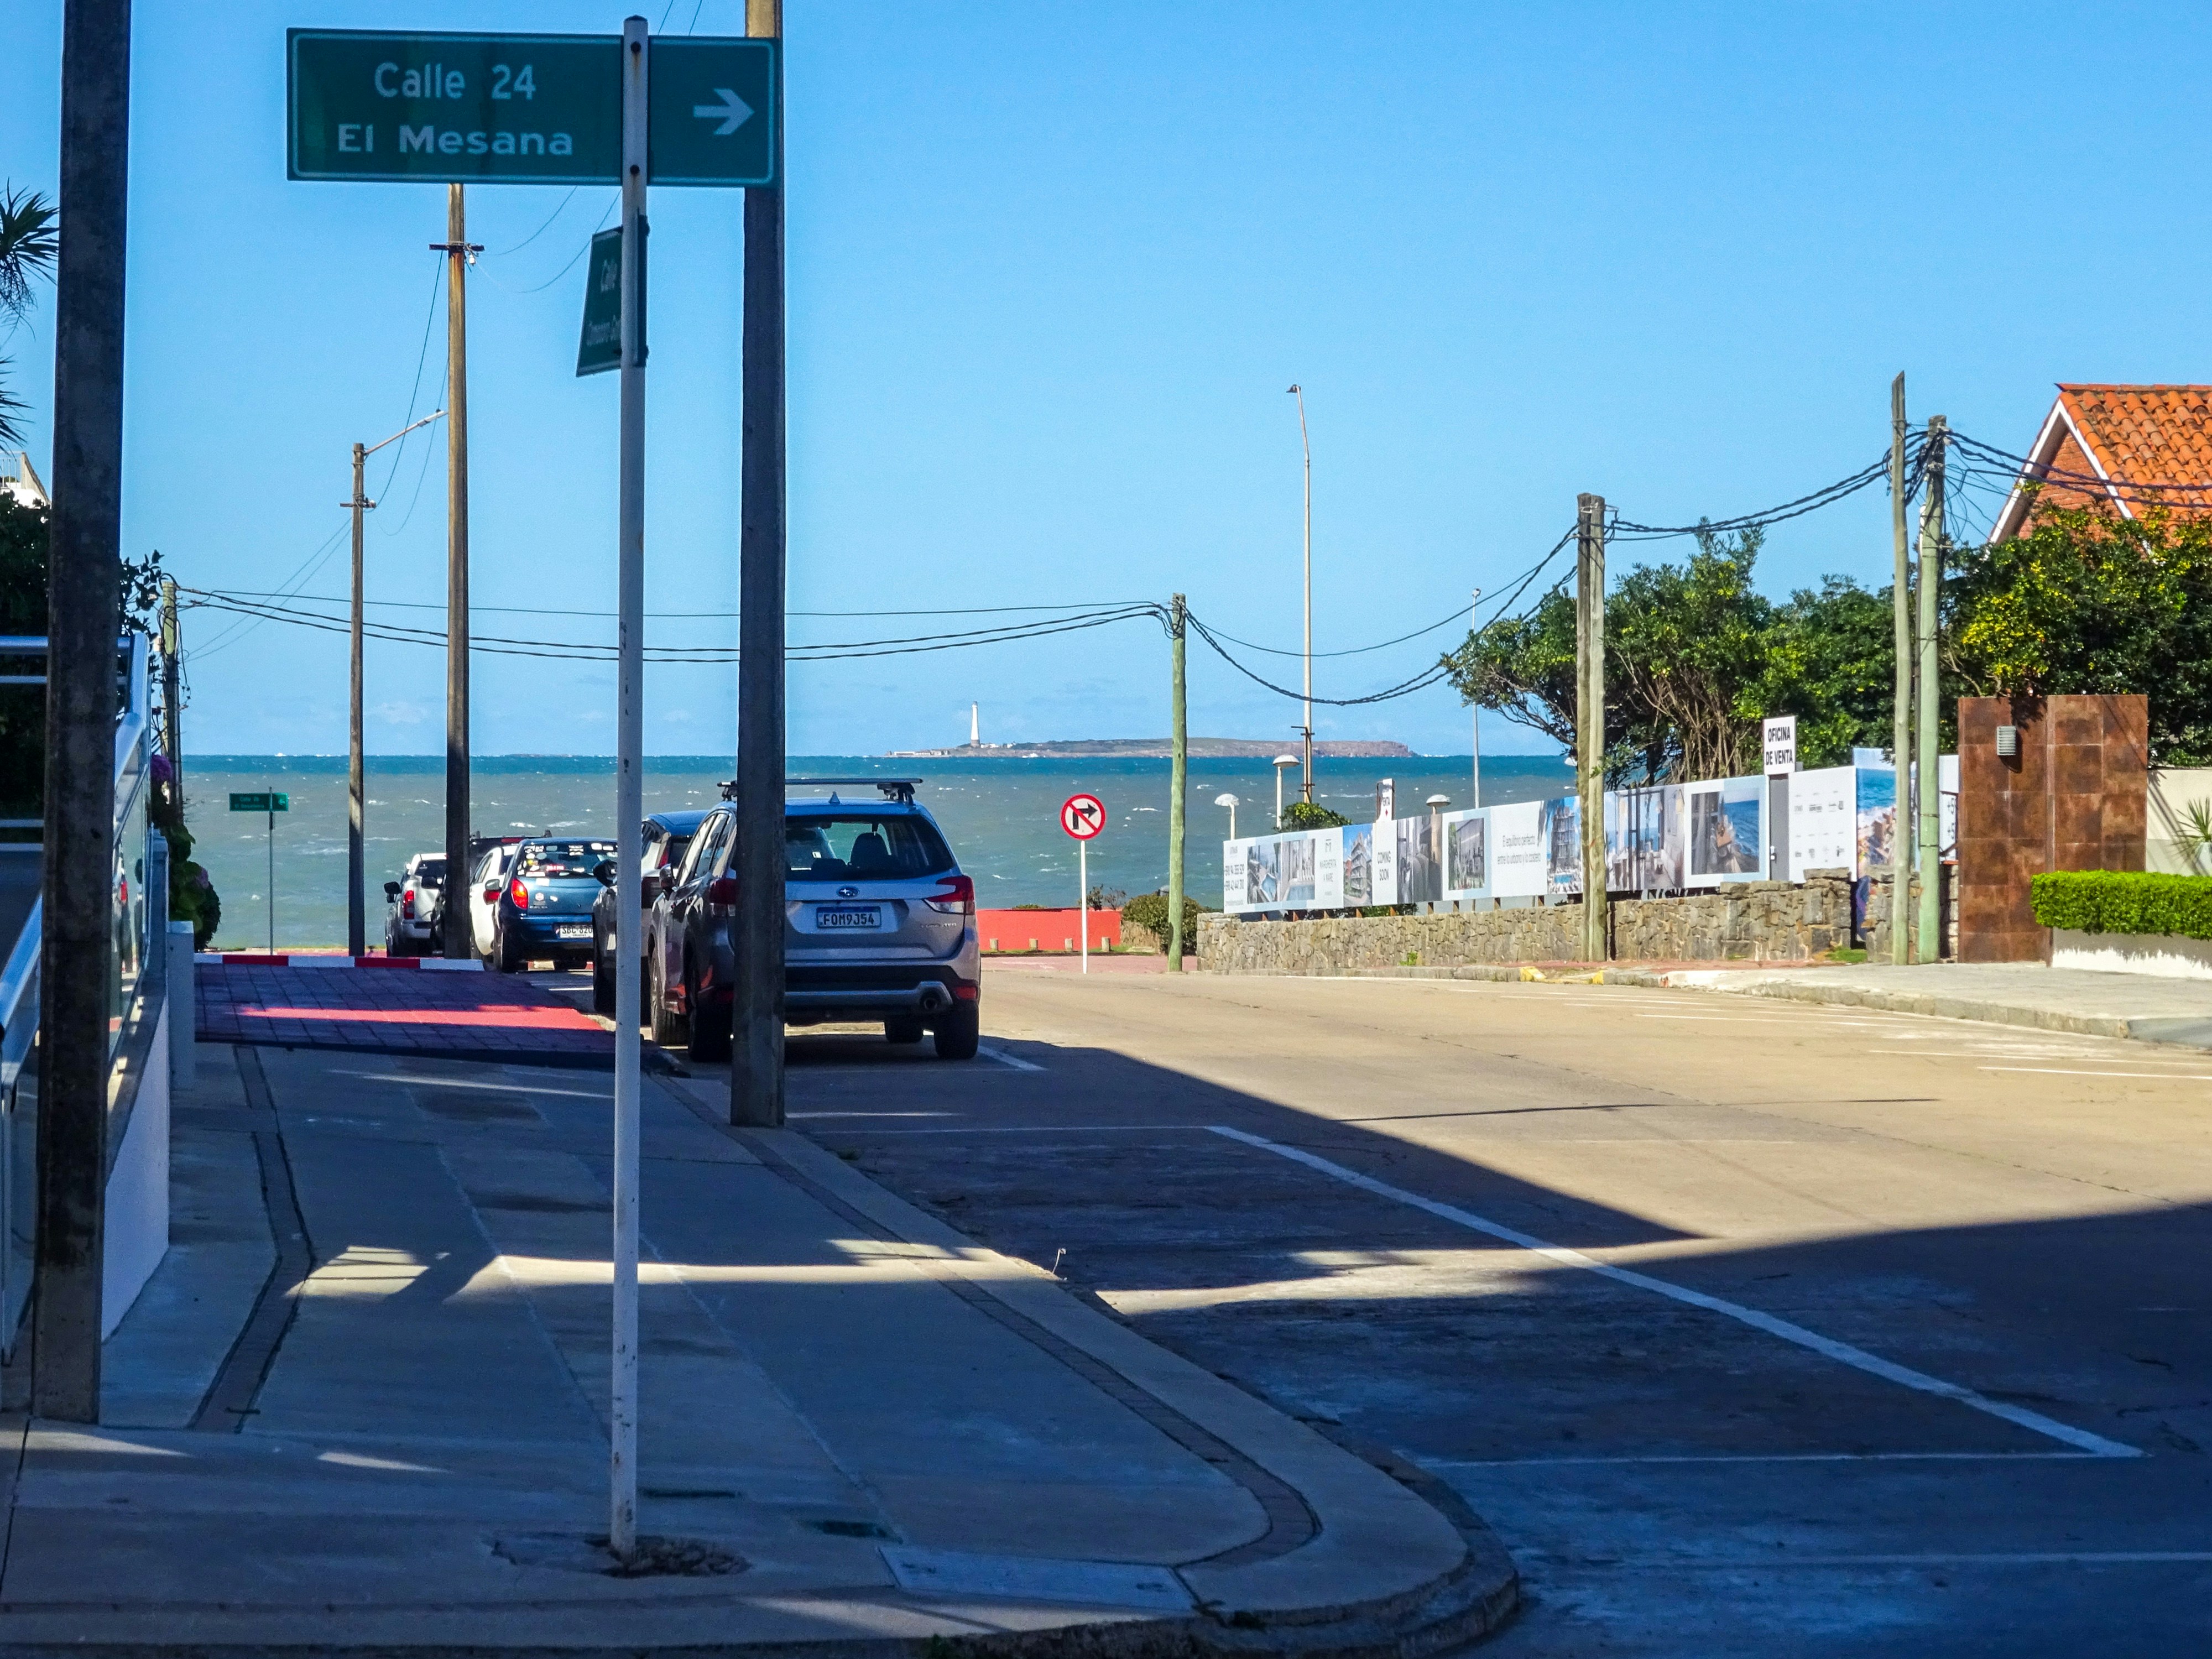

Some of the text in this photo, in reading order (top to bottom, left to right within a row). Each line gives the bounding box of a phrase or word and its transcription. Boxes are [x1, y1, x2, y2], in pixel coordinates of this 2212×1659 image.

[374, 61, 538, 100] Calle 24
[337, 123, 574, 156] El Mesana
[1768, 726, 1791, 743] OFICINA
[1766, 748, 1793, 766] DE VENTA
[1377, 851, 1391, 864] COMING
[1379, 868, 1390, 881] SOON
